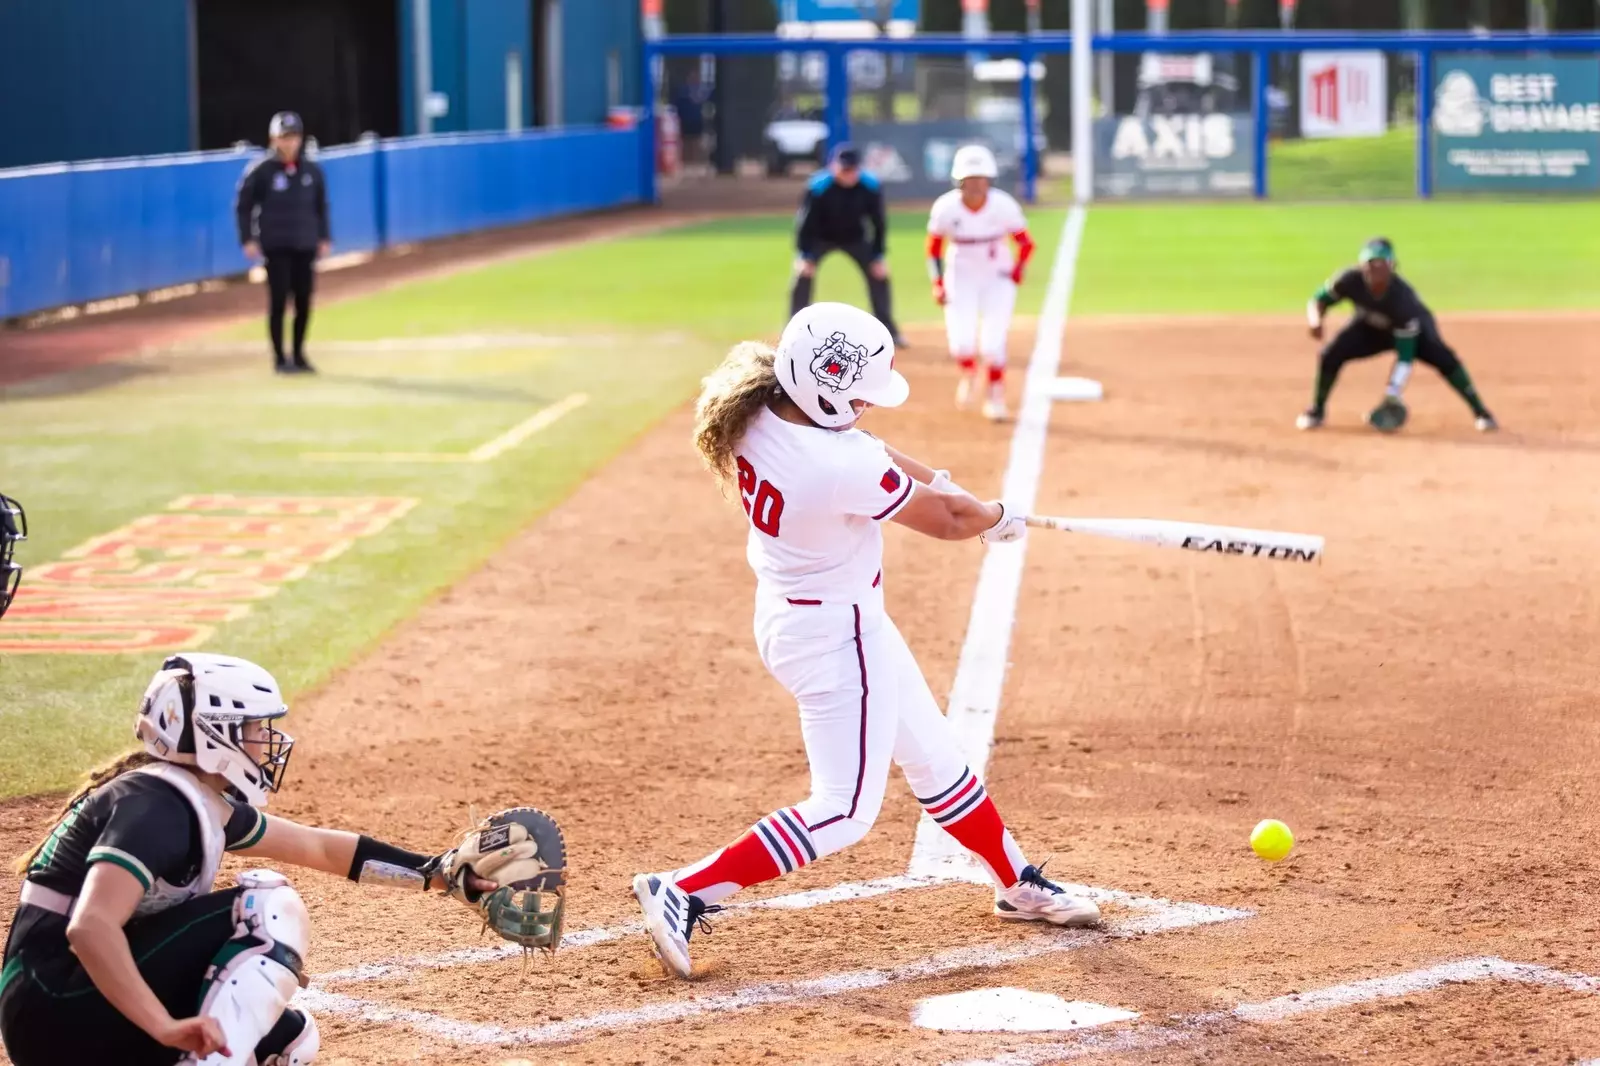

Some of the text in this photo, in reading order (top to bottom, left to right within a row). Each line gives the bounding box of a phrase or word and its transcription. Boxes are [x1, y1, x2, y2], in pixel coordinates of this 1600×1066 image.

[1490, 73, 1556, 102] BEST
[1111, 112, 1235, 160] AXIS
[736, 455, 785, 538] 20
[1180, 535, 1316, 563] EASTON
